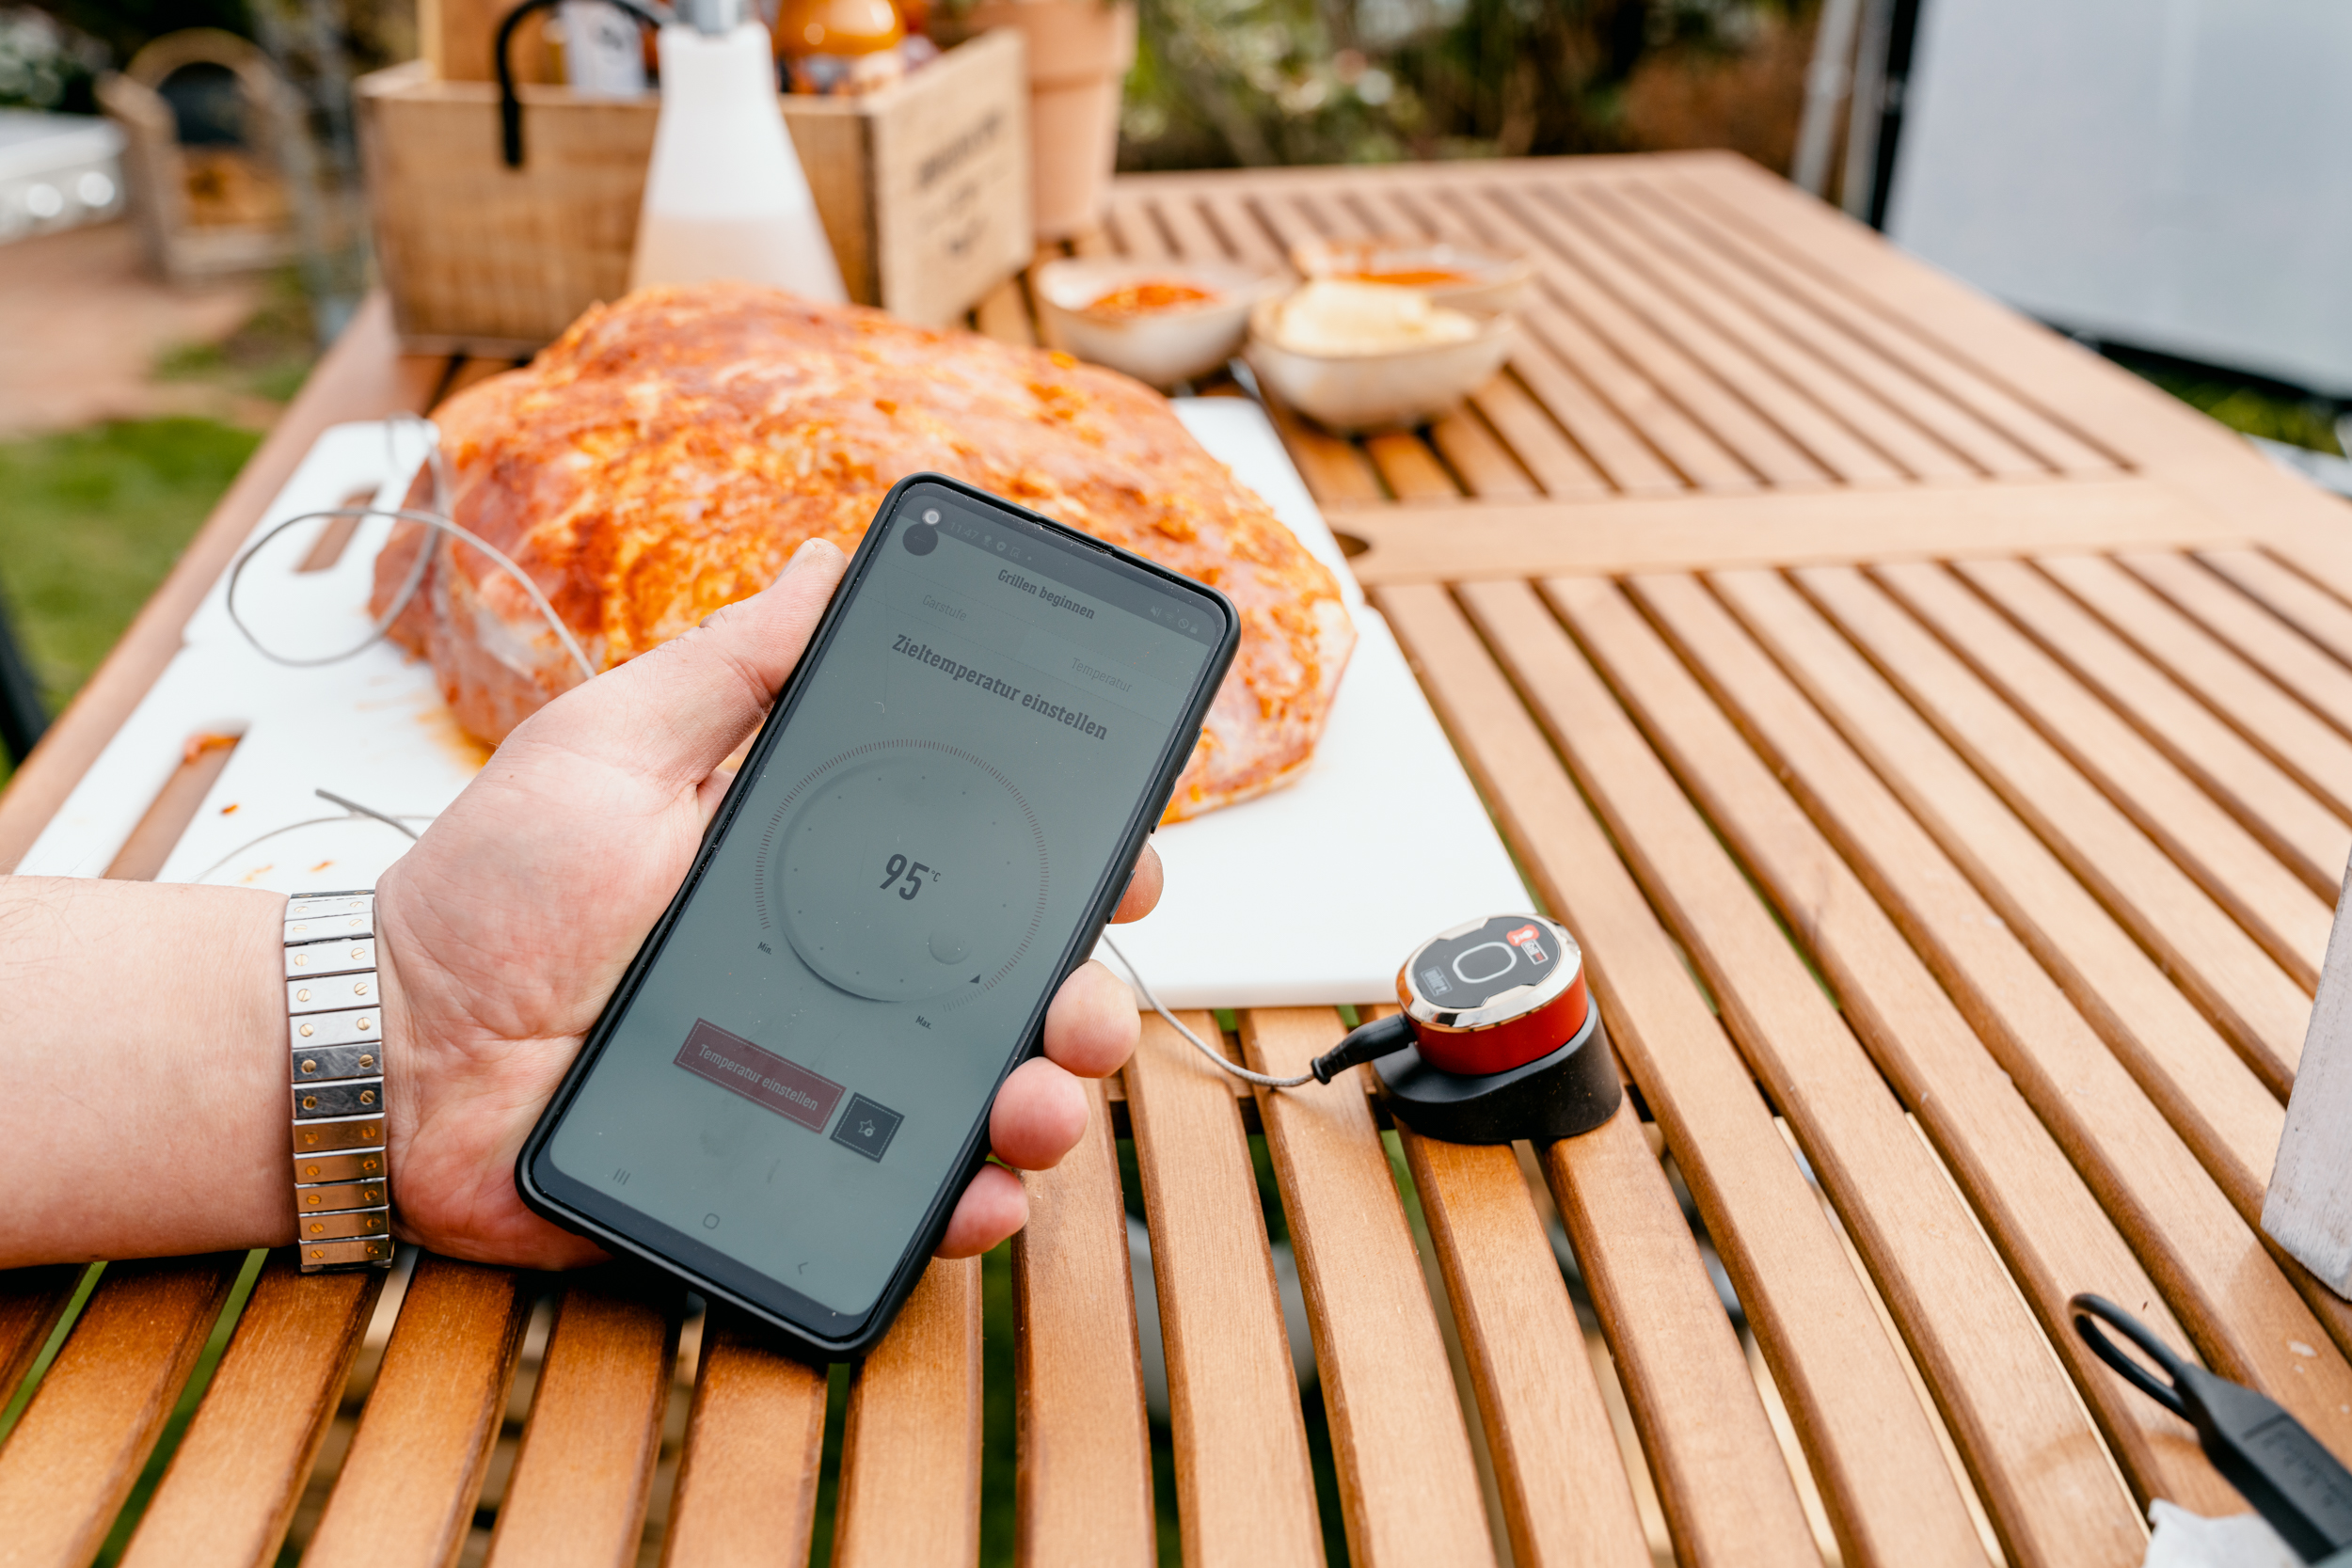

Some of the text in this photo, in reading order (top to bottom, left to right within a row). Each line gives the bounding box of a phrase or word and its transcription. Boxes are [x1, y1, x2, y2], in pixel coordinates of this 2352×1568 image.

[922, 594, 967, 622] Garstufe
[997, 569, 1095, 620] Grillen beginnen
[892, 634, 1108, 740] Zieltemperatur einstellen
[1072, 657, 1133, 693] Temperatur
[757, 942, 772, 955] Min.
[915, 1015, 931, 1030] Max.
[699, 1044, 818, 1111] Temperatur einstellen
